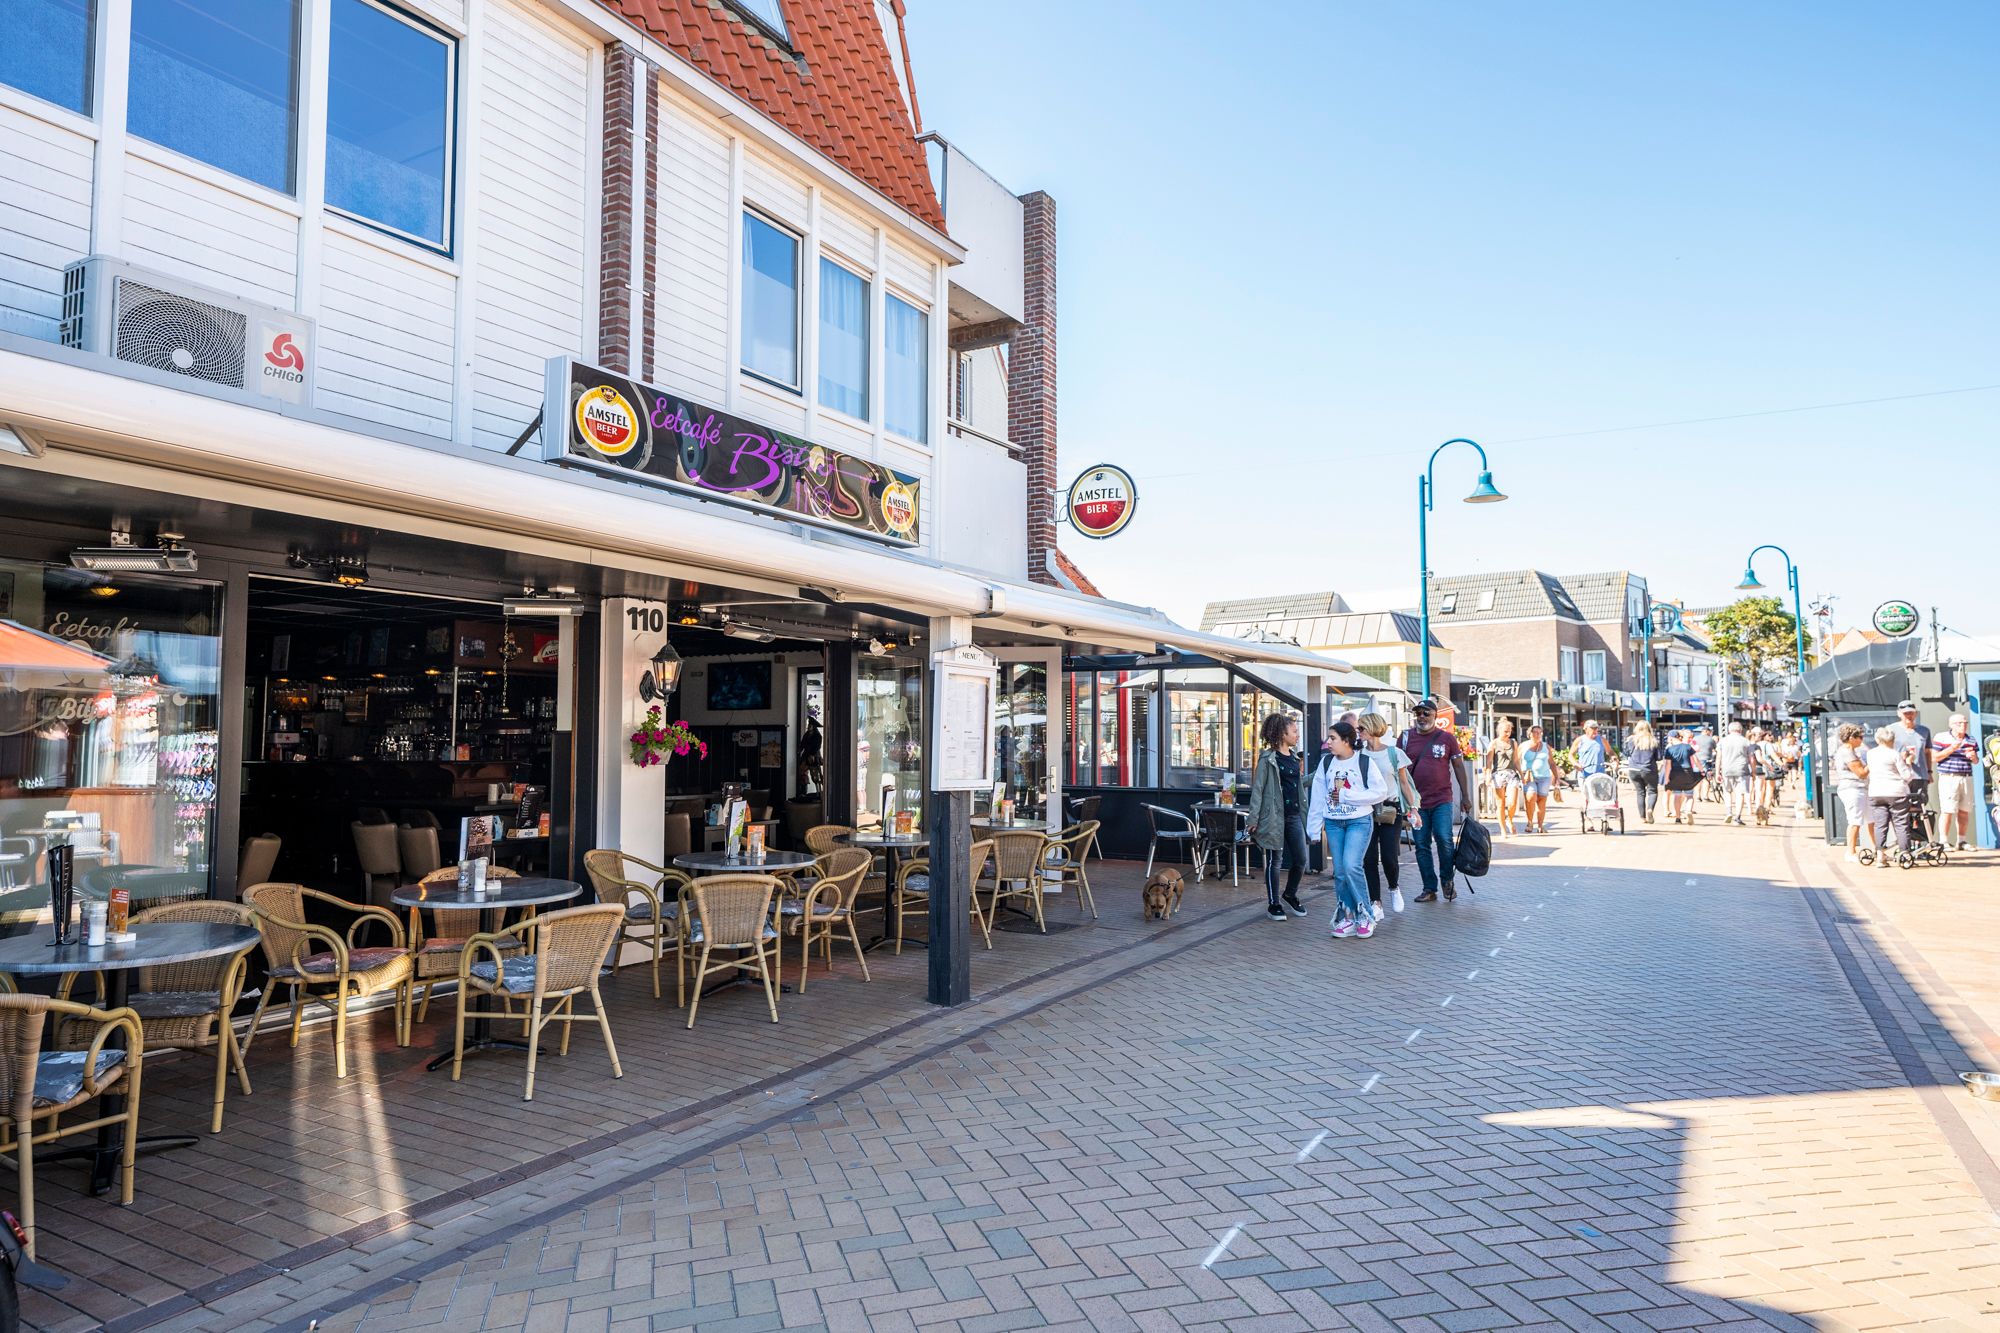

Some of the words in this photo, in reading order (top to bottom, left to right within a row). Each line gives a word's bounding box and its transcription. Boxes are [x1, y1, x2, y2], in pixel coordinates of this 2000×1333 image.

[264, 366, 304, 384] CHIGO
[587, 405, 629, 427] AMSTEL
[651, 397, 722, 449] Eetcafé
[596, 423, 618, 435] BEER
[887, 496, 910, 510] AMSTEL
[1077, 488, 1122, 502] AMSTEL
[1086, 503, 1109, 514] BIER
[49, 612, 139, 640] Eetcafé
[627, 606, 664, 633] 110
[962, 651, 977, 661] MENU
